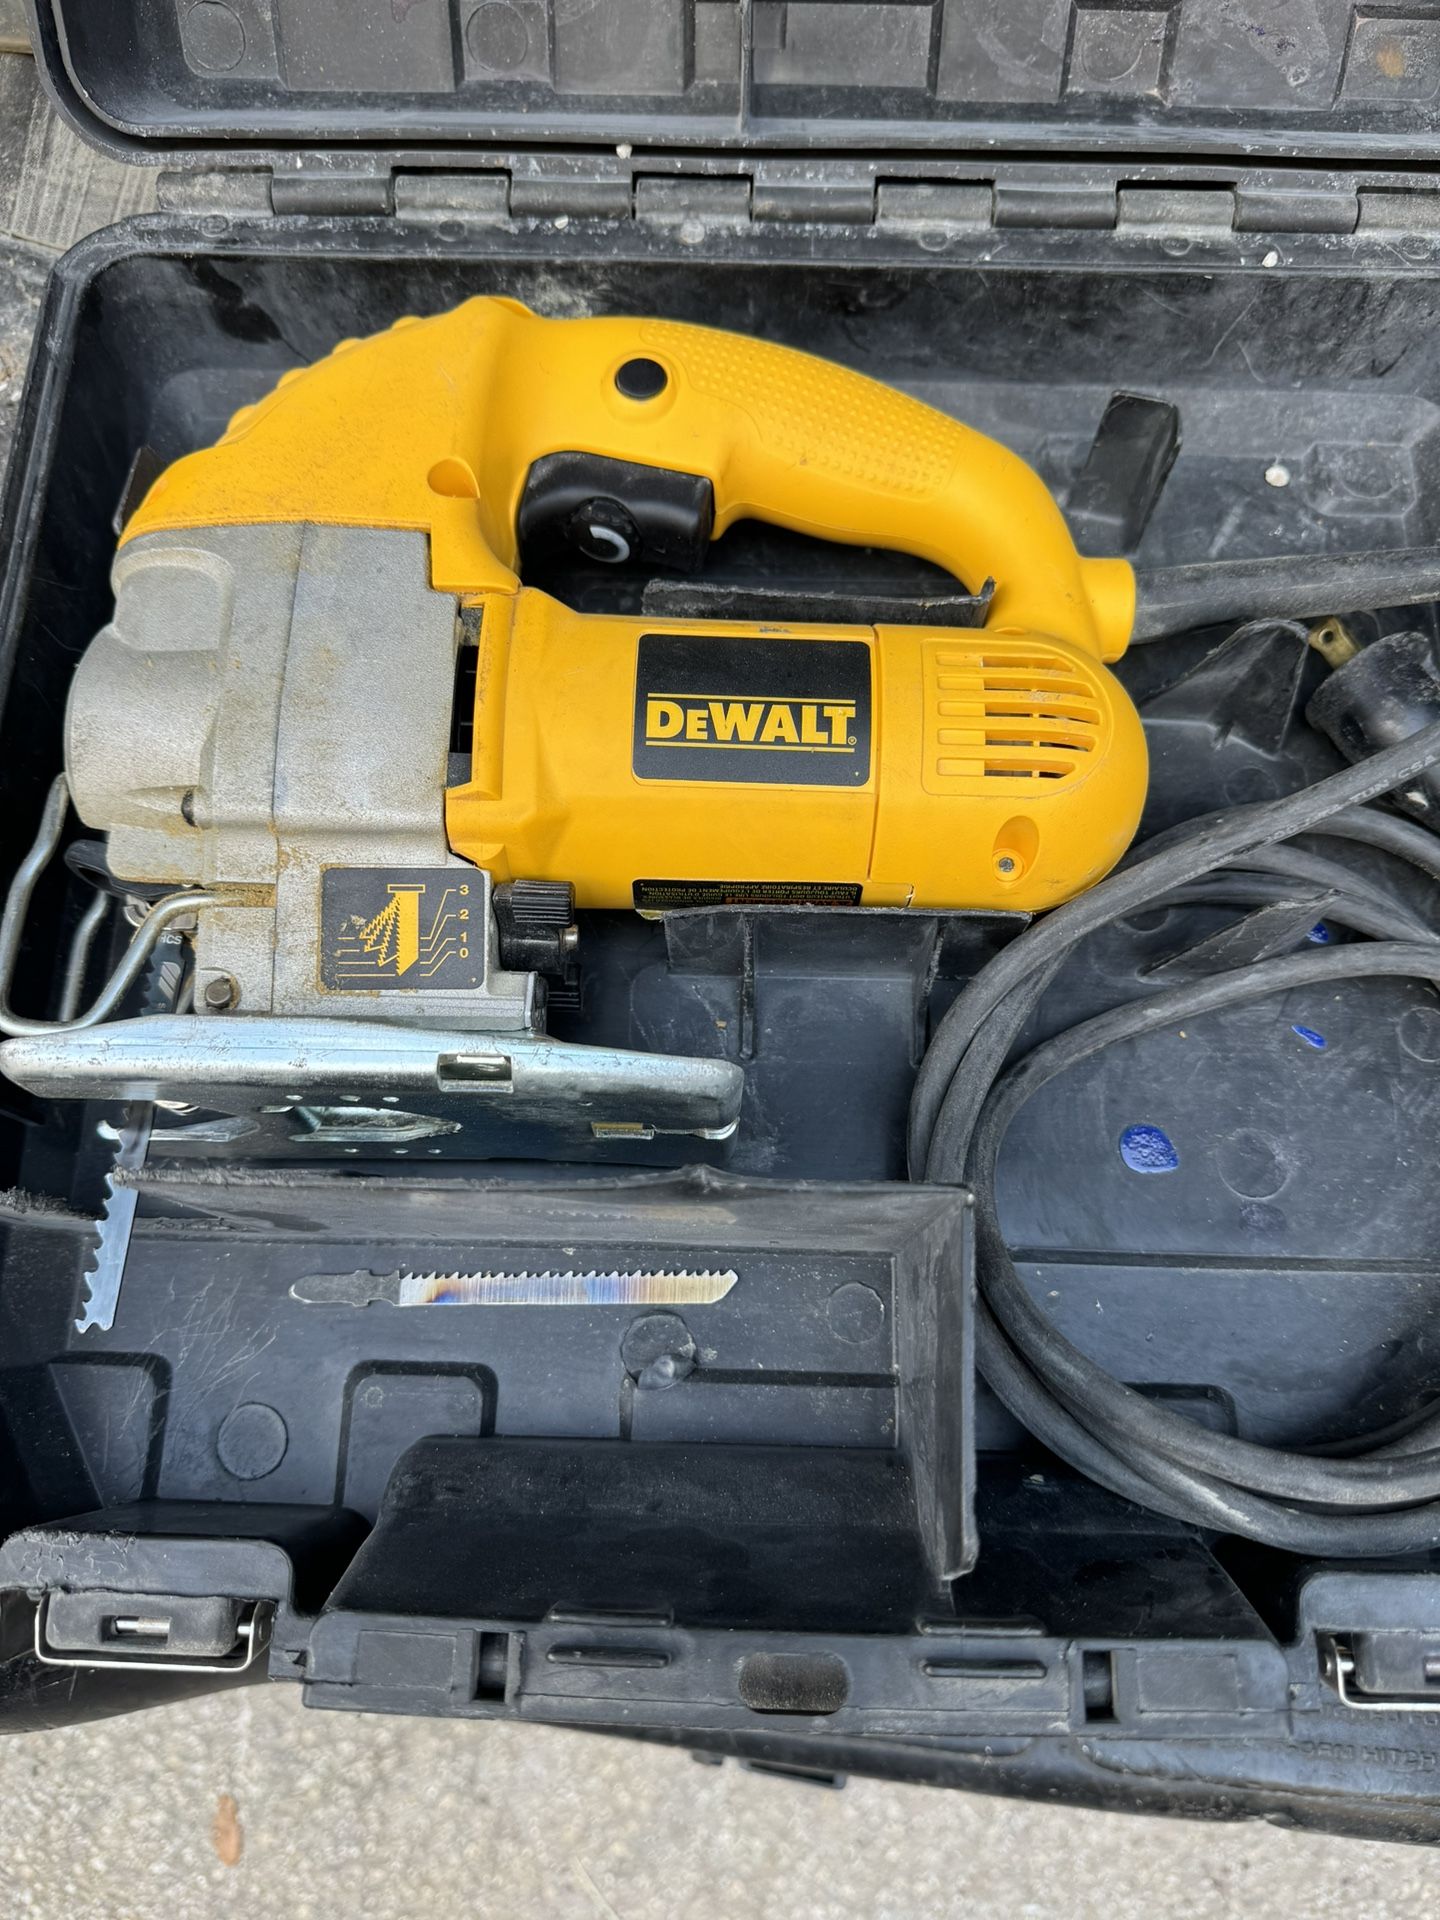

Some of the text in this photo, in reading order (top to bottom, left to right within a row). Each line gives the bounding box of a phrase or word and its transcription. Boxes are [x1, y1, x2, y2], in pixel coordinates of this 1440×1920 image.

[1399, 753, 1436, 779] CSA
[459, 884, 470, 896] 3
[459, 908, 470, 920] 2
[460, 931, 467, 943] 1
[459, 948, 470, 959] 0
